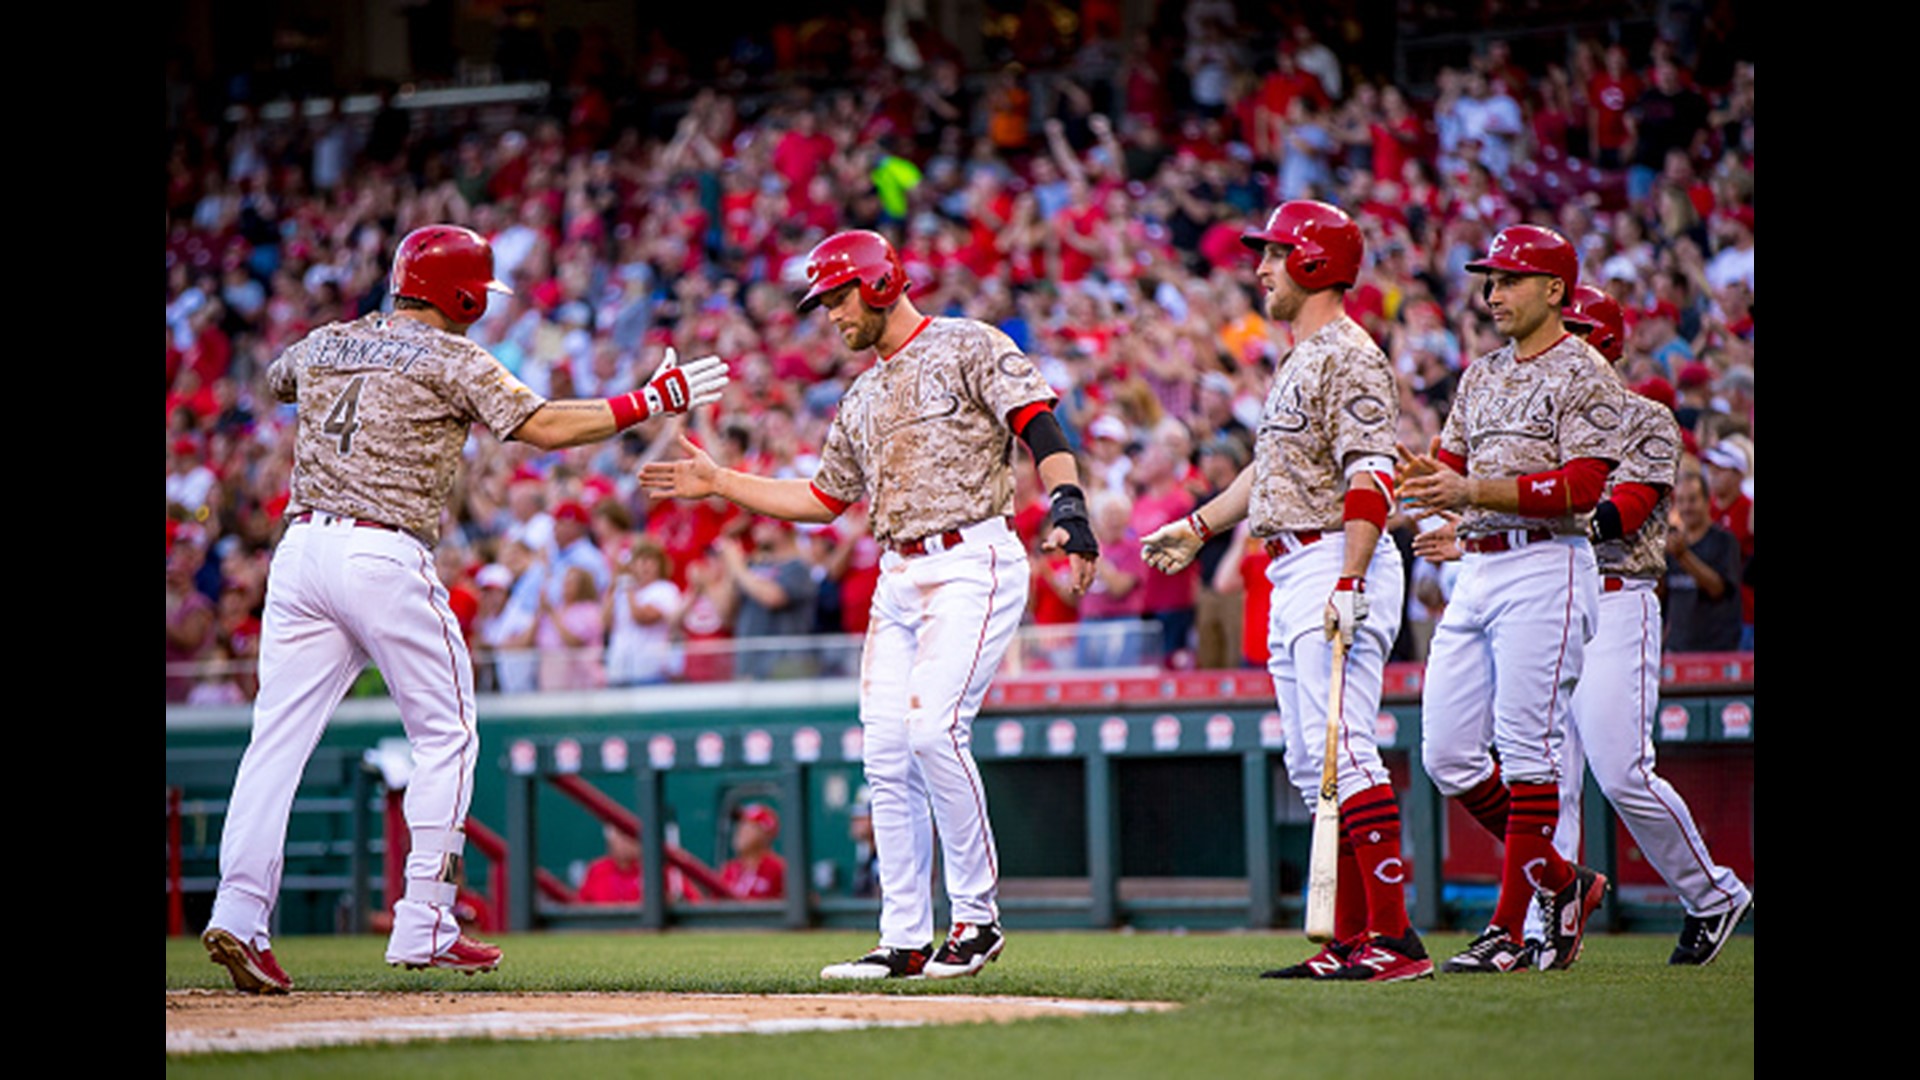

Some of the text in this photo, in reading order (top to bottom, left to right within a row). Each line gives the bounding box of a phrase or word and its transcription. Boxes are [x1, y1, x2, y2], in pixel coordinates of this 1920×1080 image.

[303, 337, 430, 374] ENNETT
[322, 375, 366, 455] 4
[1344, 393, 1387, 426] C
[1472, 379, 1556, 444] Reds
[1582, 402, 1622, 431] C
[1634, 434, 1674, 461] C
[1373, 857, 1404, 884] C
